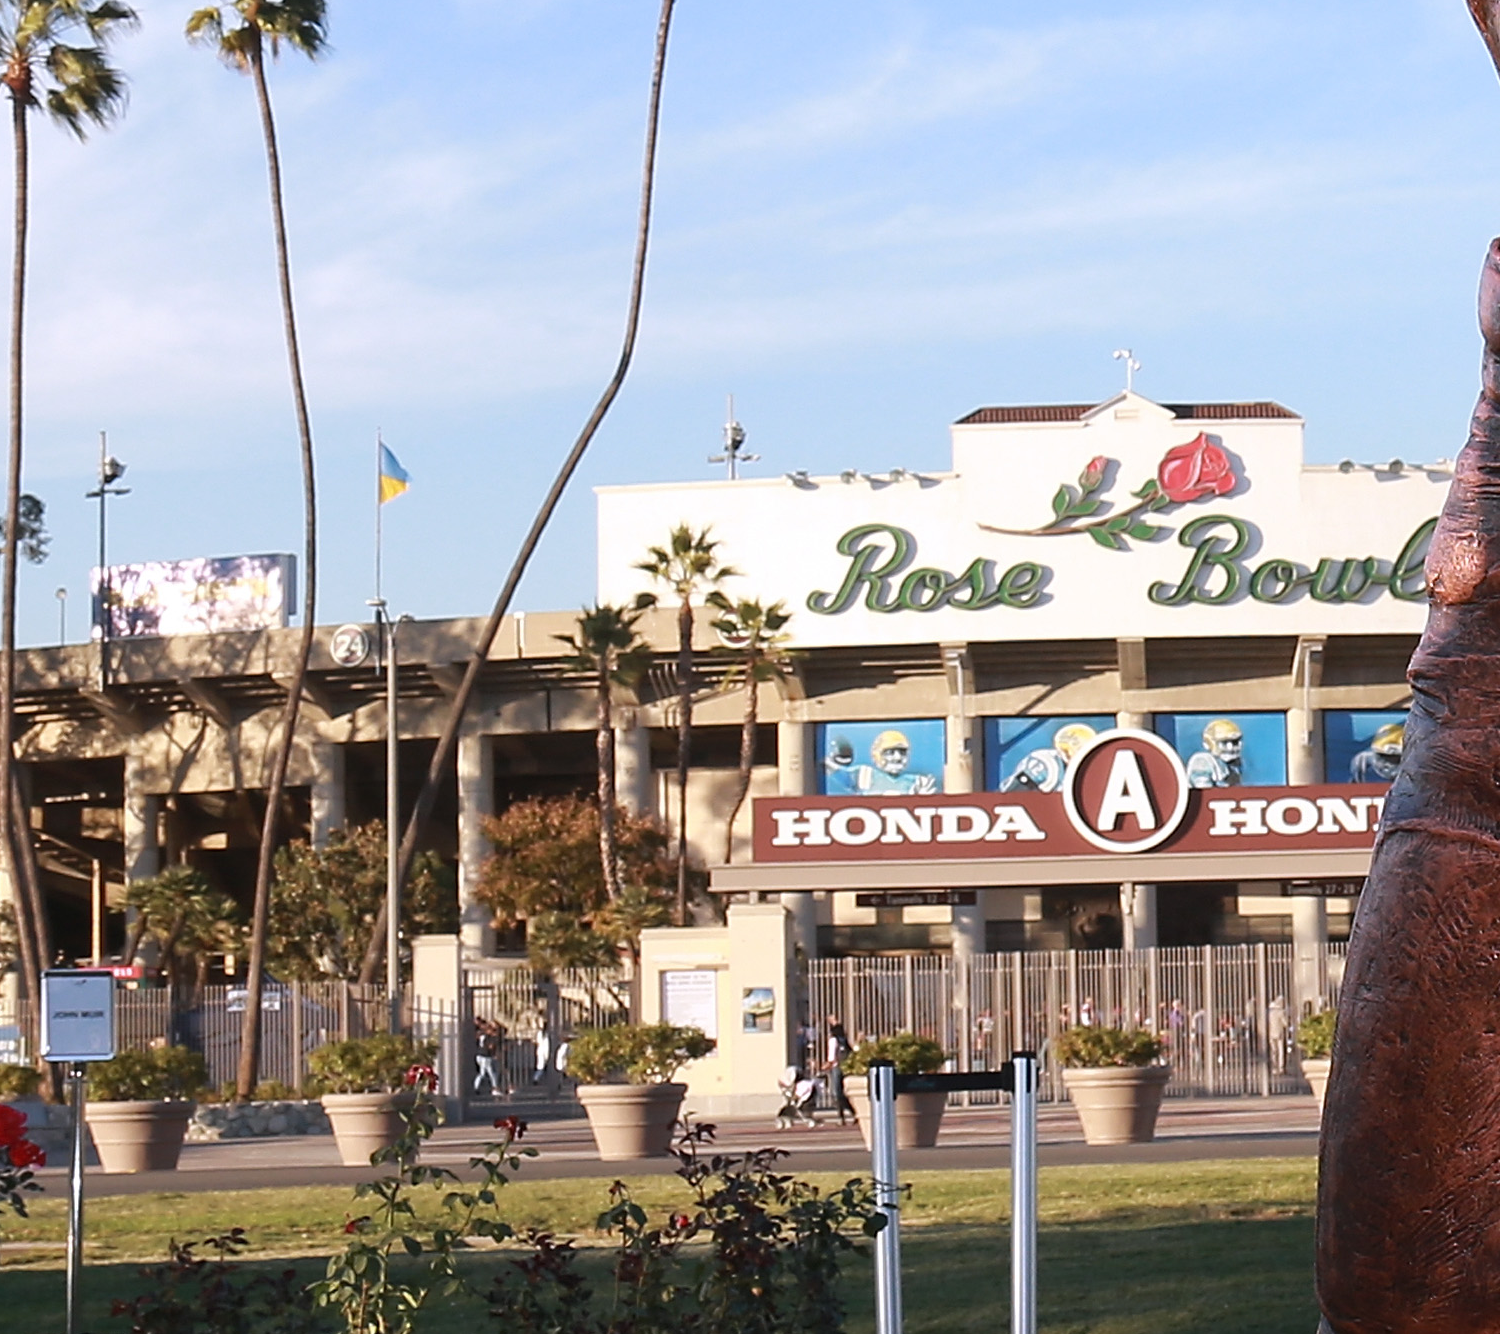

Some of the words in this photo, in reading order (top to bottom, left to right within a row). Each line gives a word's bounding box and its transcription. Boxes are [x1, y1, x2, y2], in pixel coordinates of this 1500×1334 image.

[806, 522, 1041, 614] Rose
[335, 634, 363, 658] 24
[1097, 749, 1156, 832] A
[771, 805, 1046, 846] HONDA
[1208, 796, 1386, 836] HON
